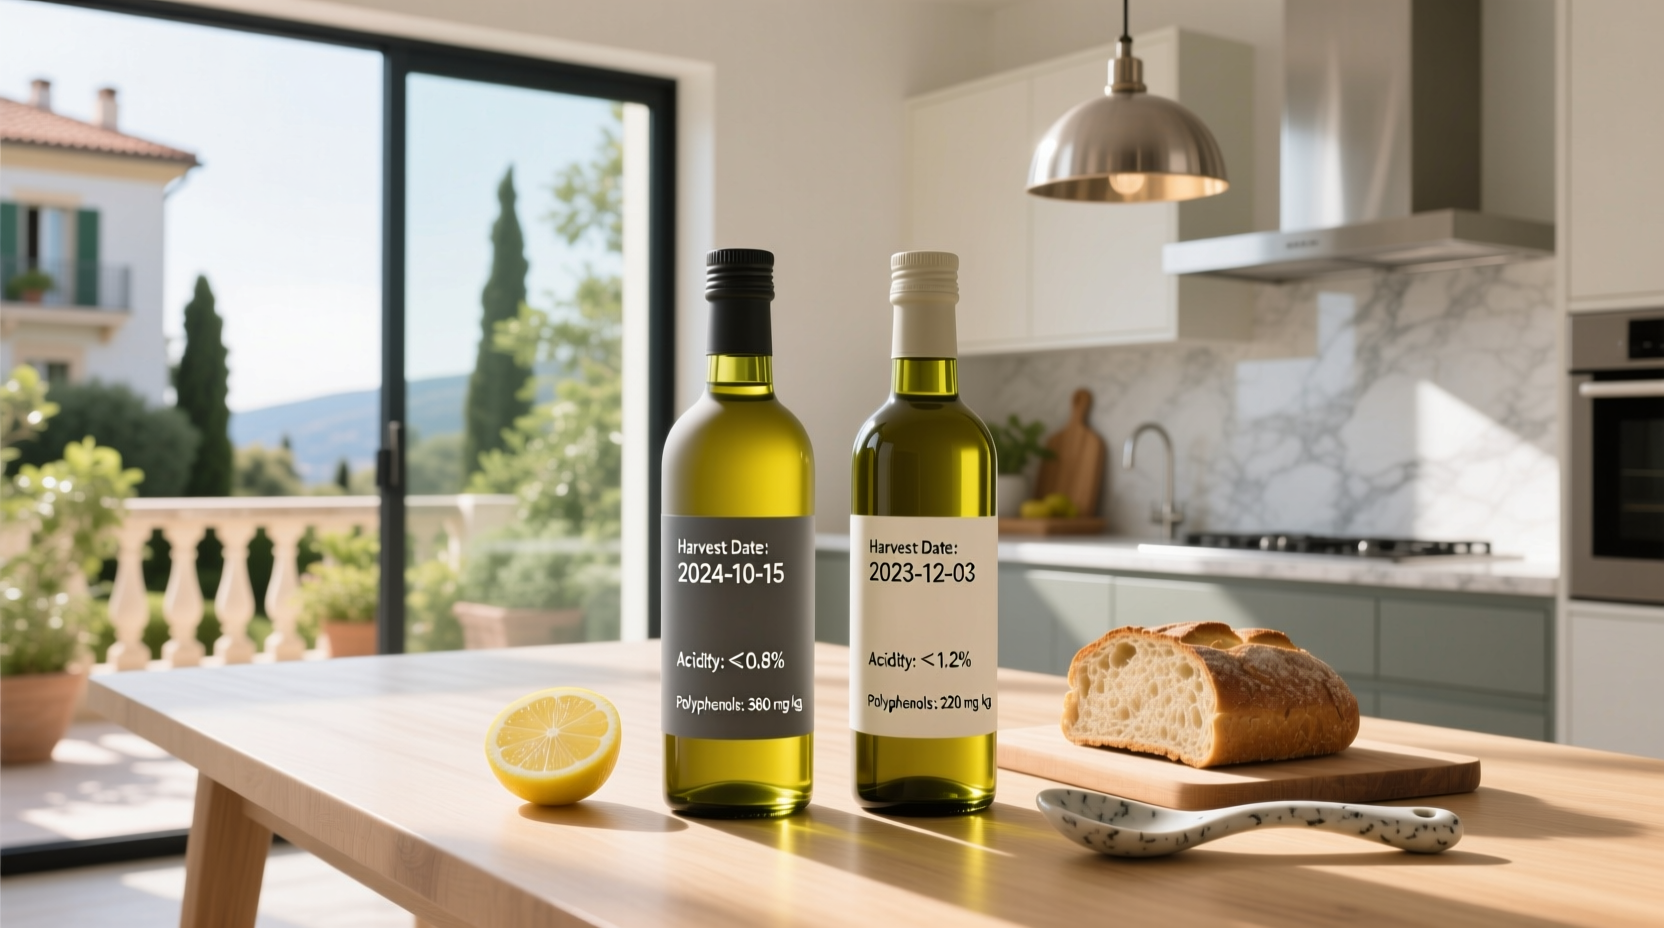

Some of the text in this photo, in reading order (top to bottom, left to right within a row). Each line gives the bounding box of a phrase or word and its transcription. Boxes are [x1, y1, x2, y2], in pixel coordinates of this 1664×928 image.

[677, 538, 768, 555] Harvest Date:
[869, 539, 958, 555] Harvest Date:
[677, 562, 785, 584] 2024-10-15
[869, 562, 976, 583] 2023-12-03
[676, 695, 745, 715] Polyphenols:
[747, 698, 771, 711] 380
[773, 700, 790, 713] mg
[867, 694, 938, 713] Polyphenols:
[940, 696, 961, 709] 220
[964, 699, 978, 712] mg
